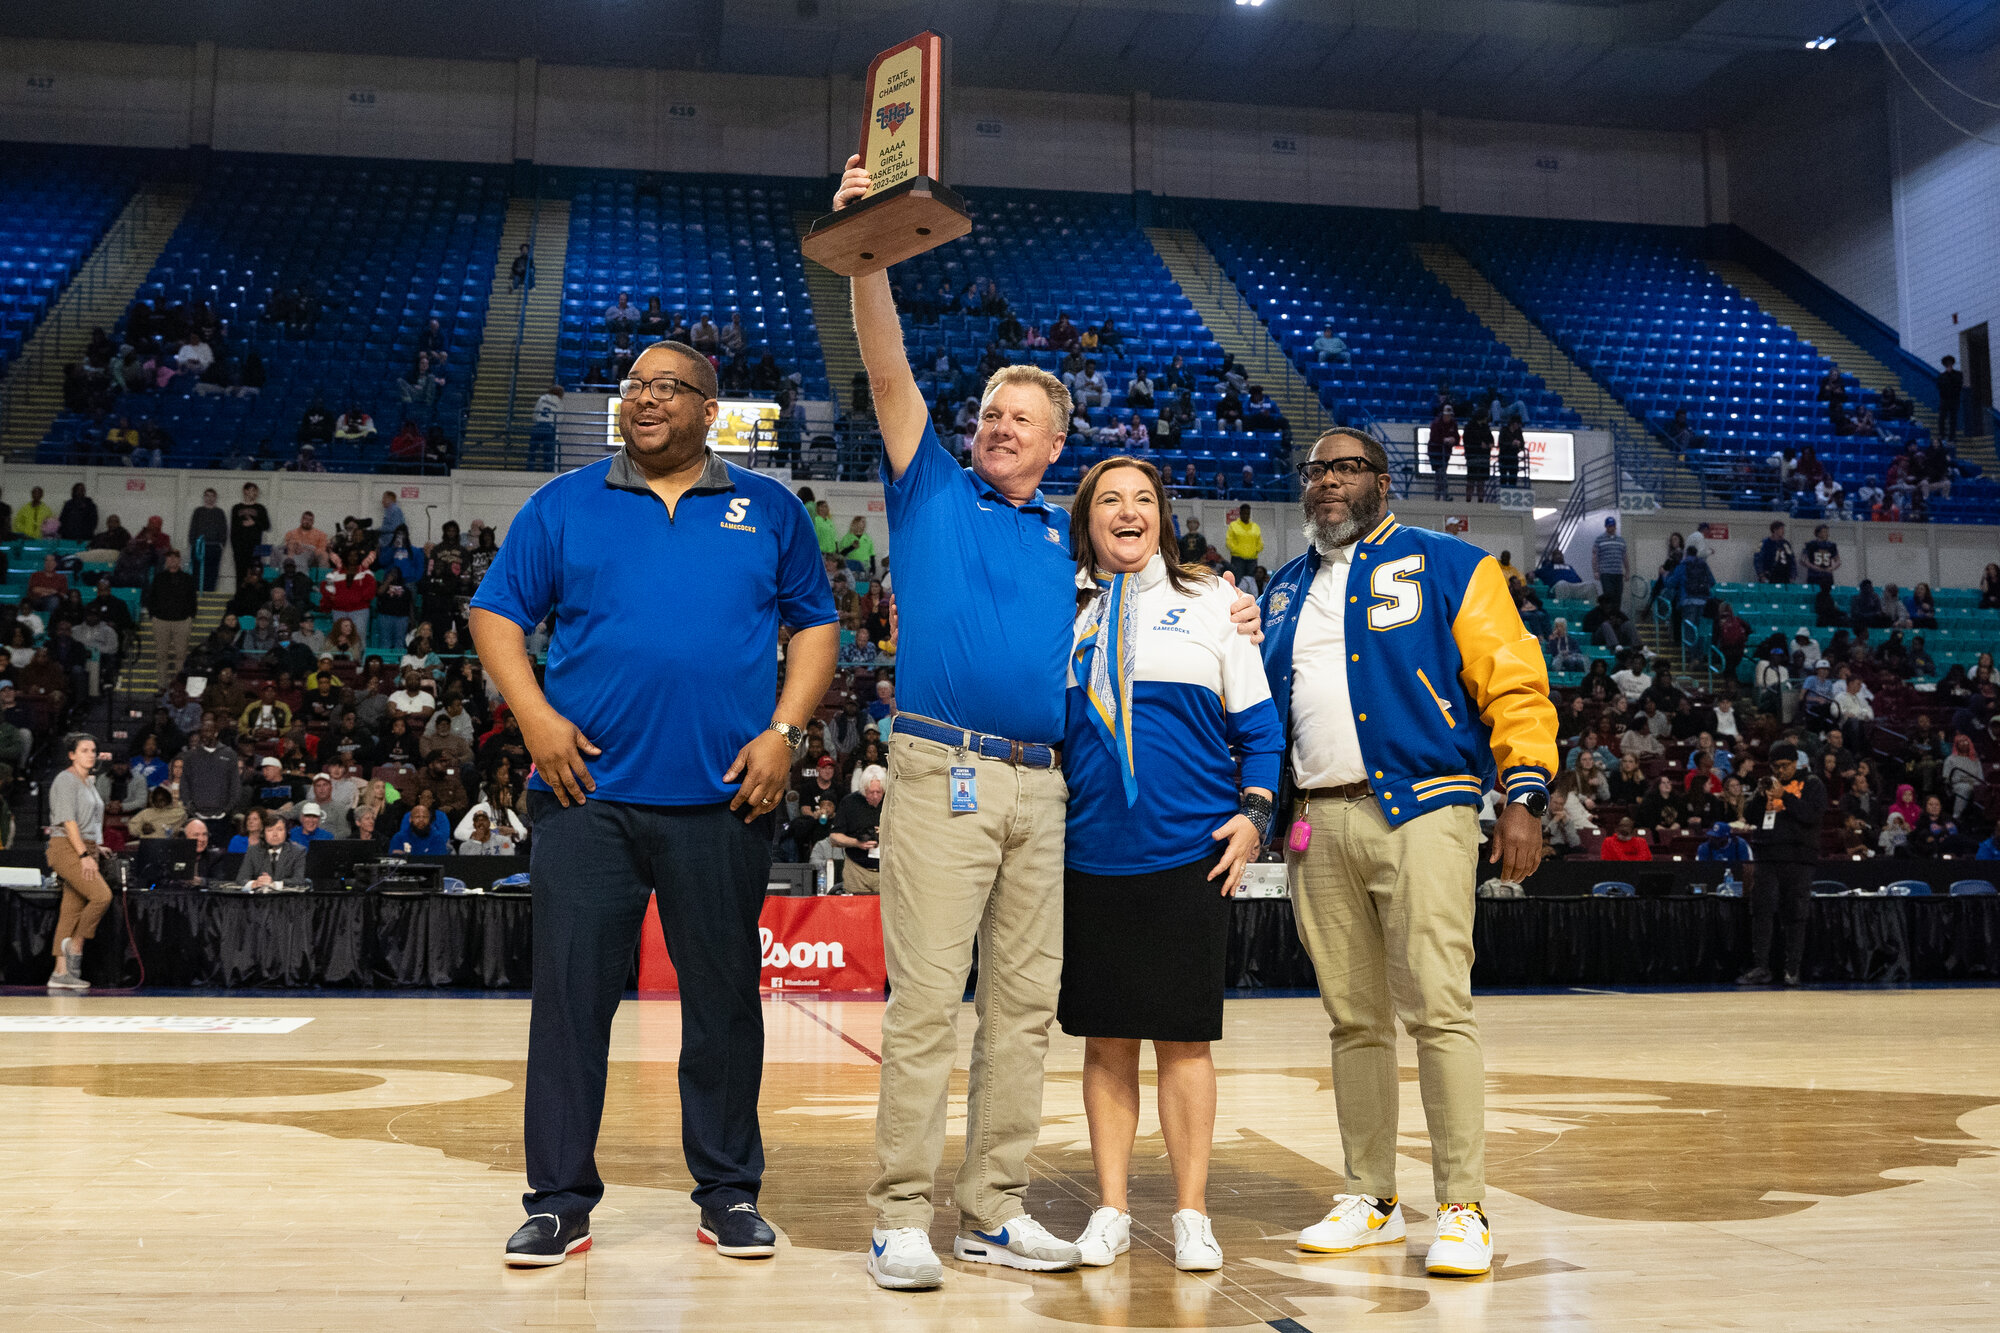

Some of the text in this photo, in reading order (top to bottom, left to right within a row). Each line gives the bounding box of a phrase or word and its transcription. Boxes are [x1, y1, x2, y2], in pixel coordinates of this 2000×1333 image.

[887, 69, 908, 85] STATE
[878, 76, 915, 98] CHAMPION
[879, 140, 906, 158] AAAAA
[880, 151, 903, 167] GIRLS
[872, 169, 908, 191] 2023-2024
[1500, 491, 1535, 508] 323
[1621, 494, 1655, 511] 324
[725, 498, 751, 523] S
[720, 521, 756, 533] GAMECOCKS
[1813, 551, 1832, 566] 55
[1367, 554, 1425, 632] S
[1160, 608, 1187, 625] S
[1152, 625, 1190, 635] GAMECOCKS
[759, 927, 846, 968] lson
